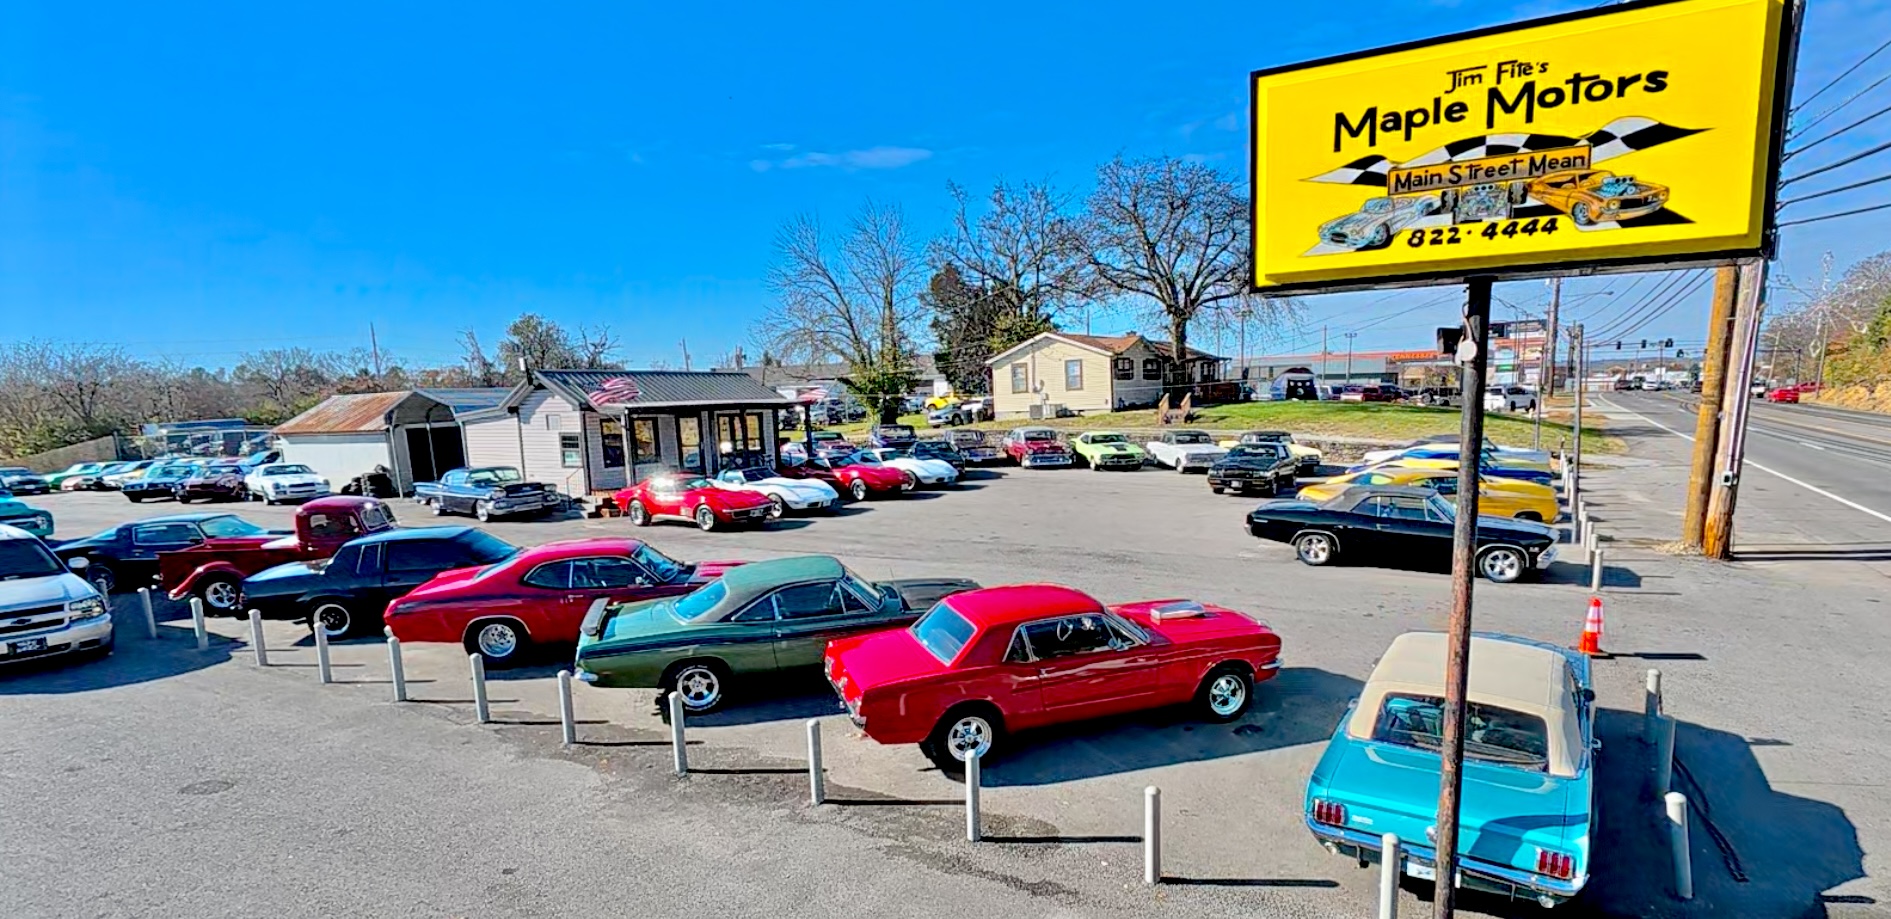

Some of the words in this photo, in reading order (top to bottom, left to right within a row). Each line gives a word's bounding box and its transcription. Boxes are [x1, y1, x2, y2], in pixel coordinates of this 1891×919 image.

[1444, 65, 1488, 94] Jim
[1496, 60, 1549, 85] Fite's
[1334, 97, 1469, 152] Maple
[1487, 70, 1669, 129] Motors
[1394, 169, 1443, 192] Main
[1448, 158, 1524, 185] Street
[1528, 153, 1586, 177] Mean
